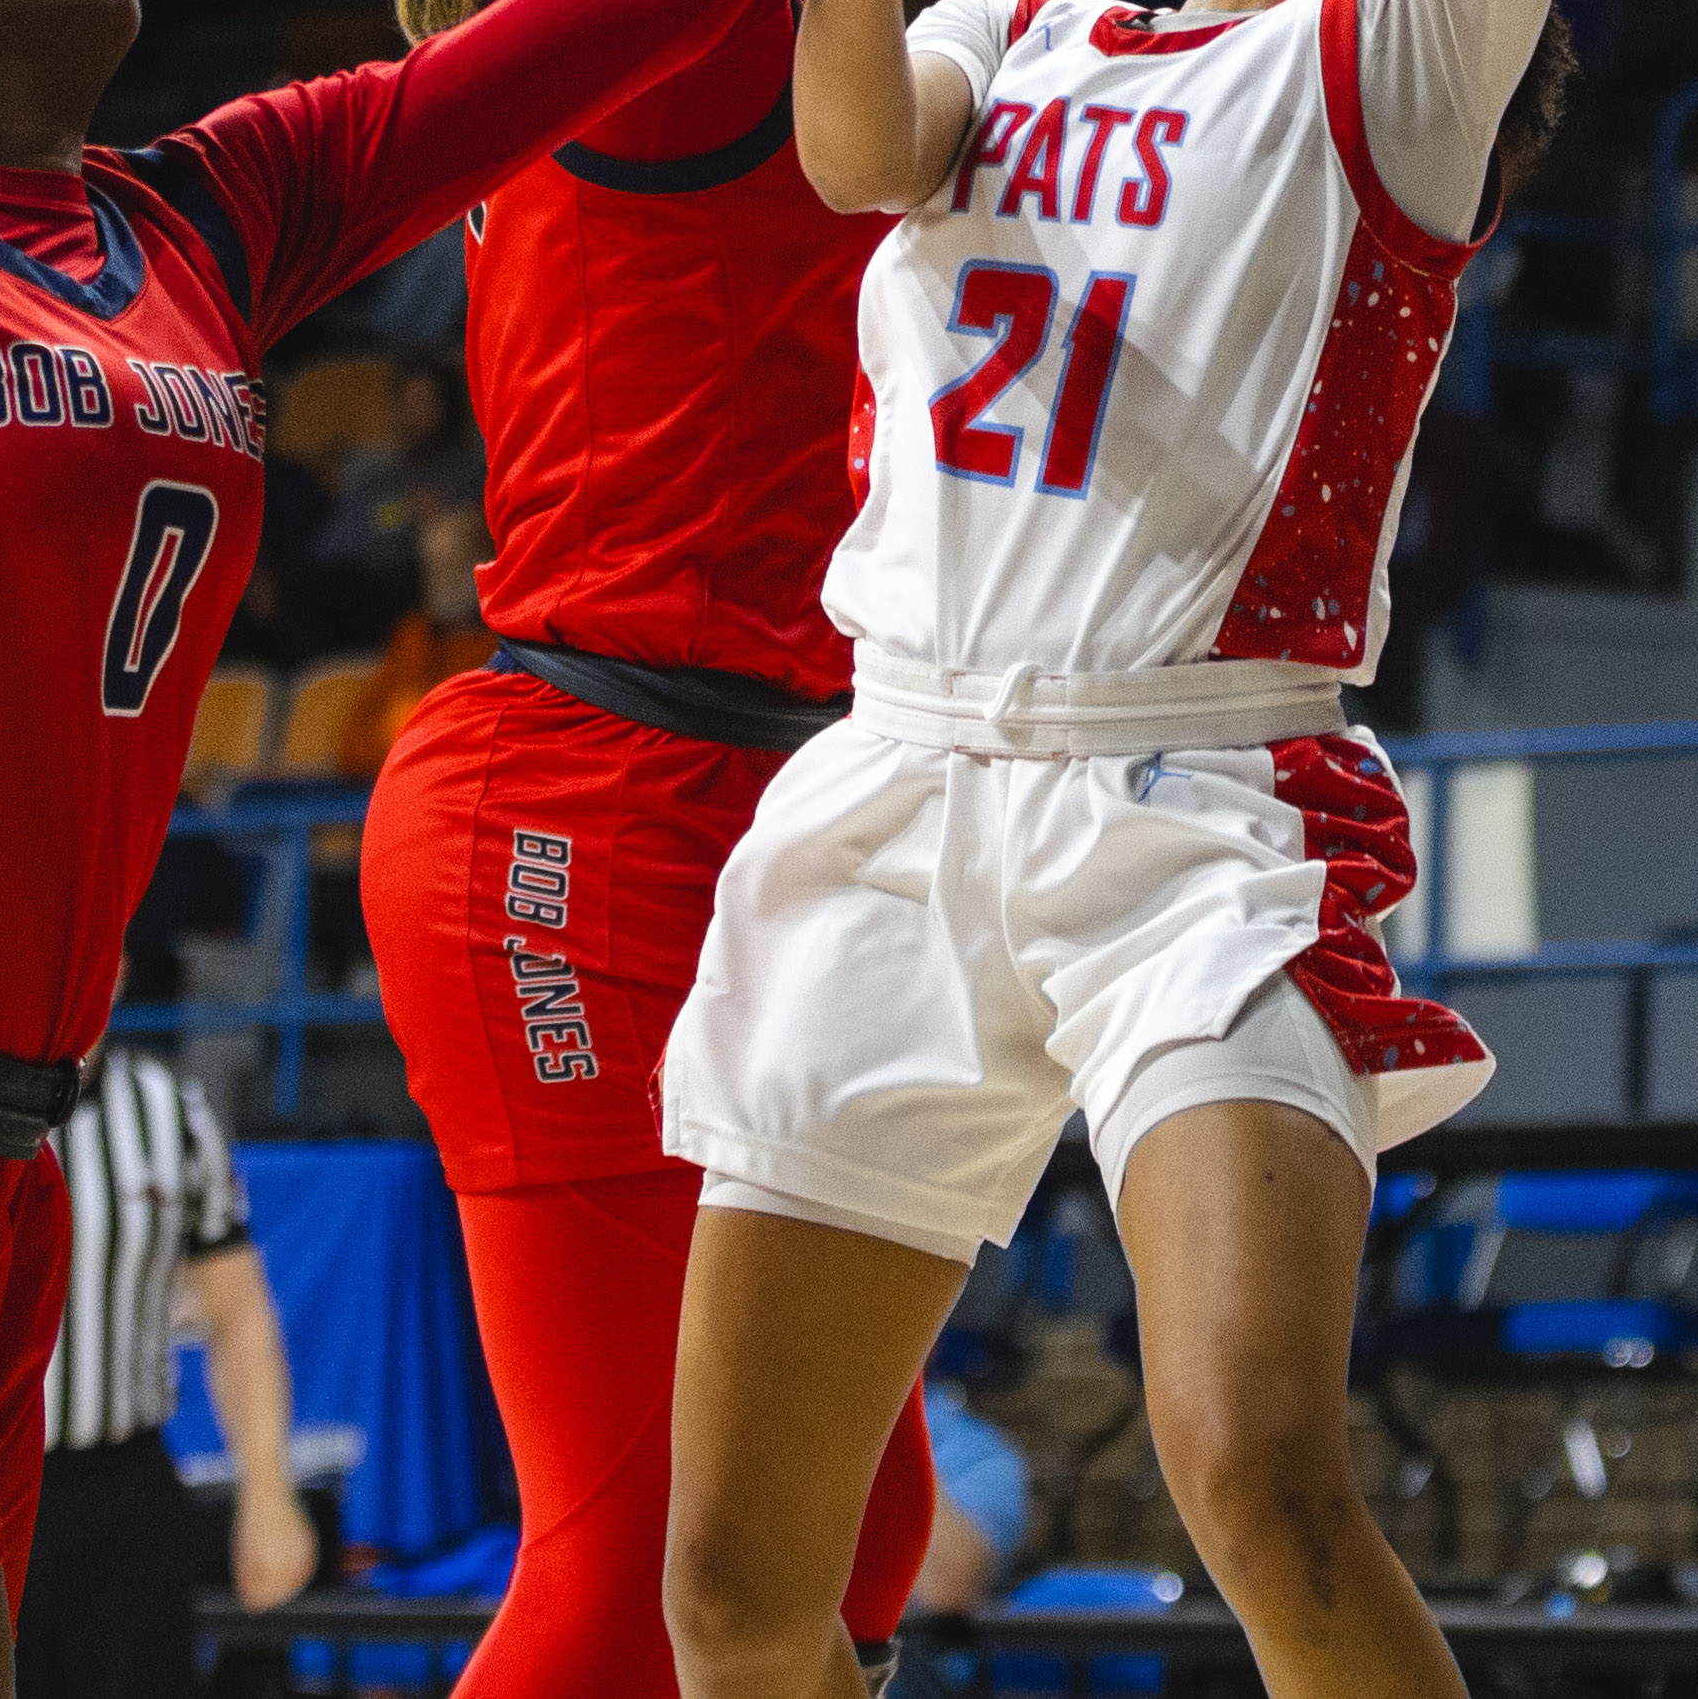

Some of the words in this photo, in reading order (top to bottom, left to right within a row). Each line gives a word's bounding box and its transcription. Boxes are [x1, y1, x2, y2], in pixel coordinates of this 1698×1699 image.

[949, 95, 1190, 230] PATS
[928, 256, 1137, 500] 21
[103, 479, 219, 718] 0
[505, 829, 572, 929] BOB
